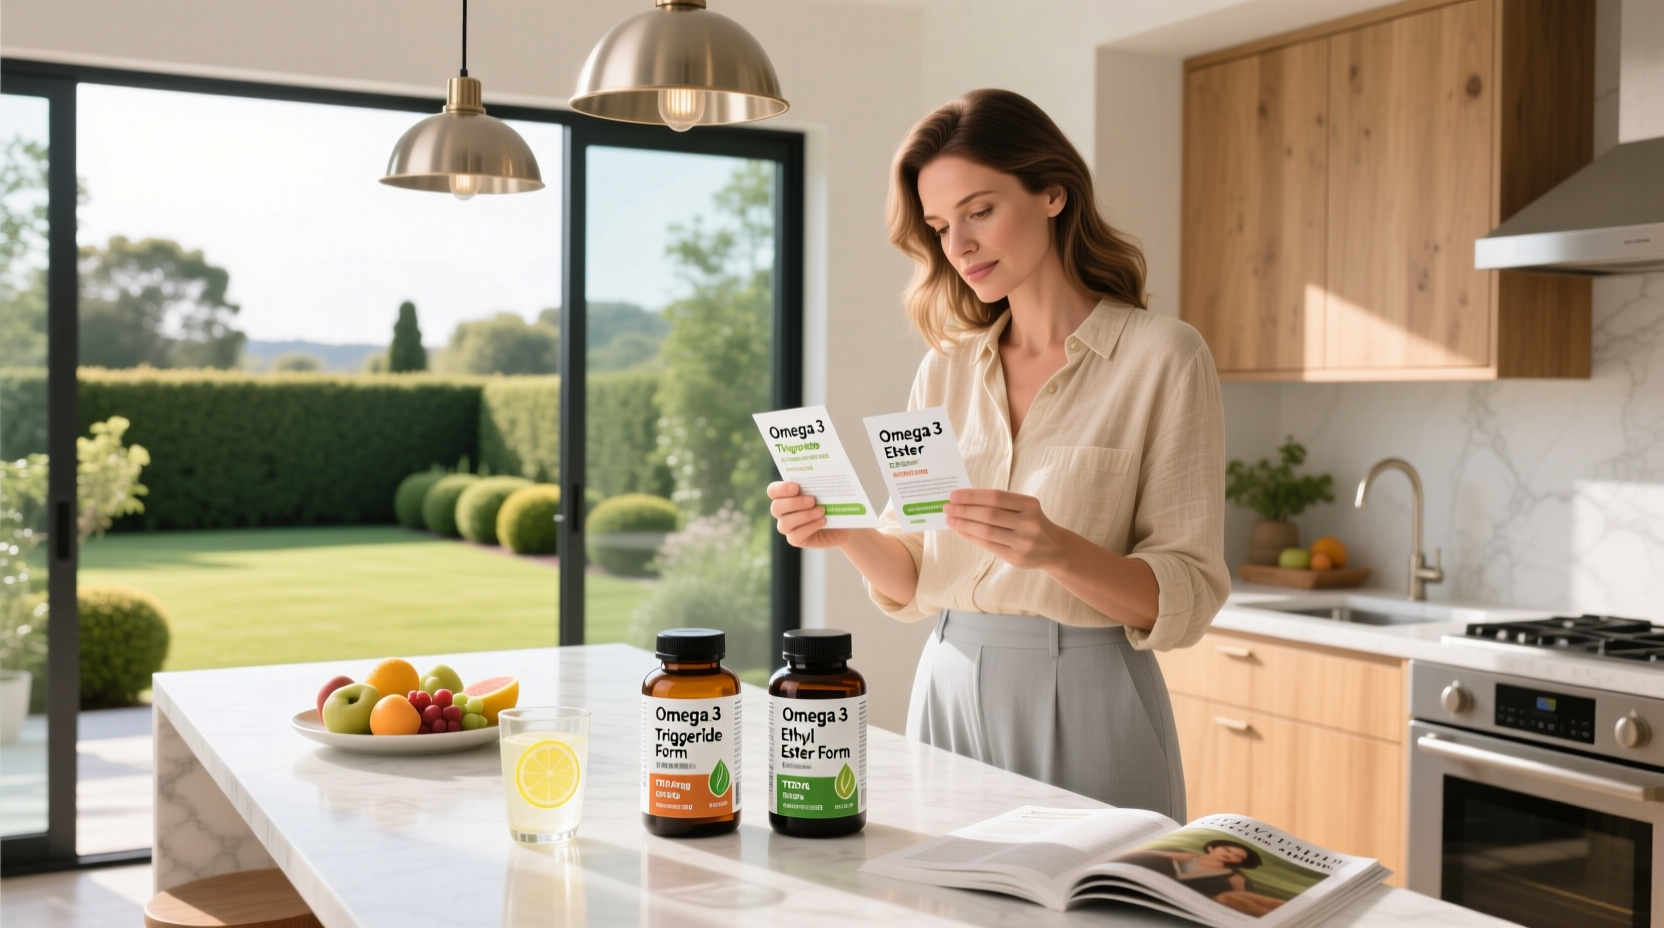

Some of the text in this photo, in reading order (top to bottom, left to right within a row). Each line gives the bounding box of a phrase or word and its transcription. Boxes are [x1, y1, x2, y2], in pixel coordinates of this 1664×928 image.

[769, 419, 825, 440] Omega 3
[879, 421, 943, 443] Omega 3
[655, 706, 722, 727] Omega 3
[782, 707, 848, 727] Omega 3
[655, 727, 723, 747] Triggeride
[781, 727, 815, 746] Ethyl
[655, 744, 688, 760] Form
[781, 744, 851, 760] Ester Form
